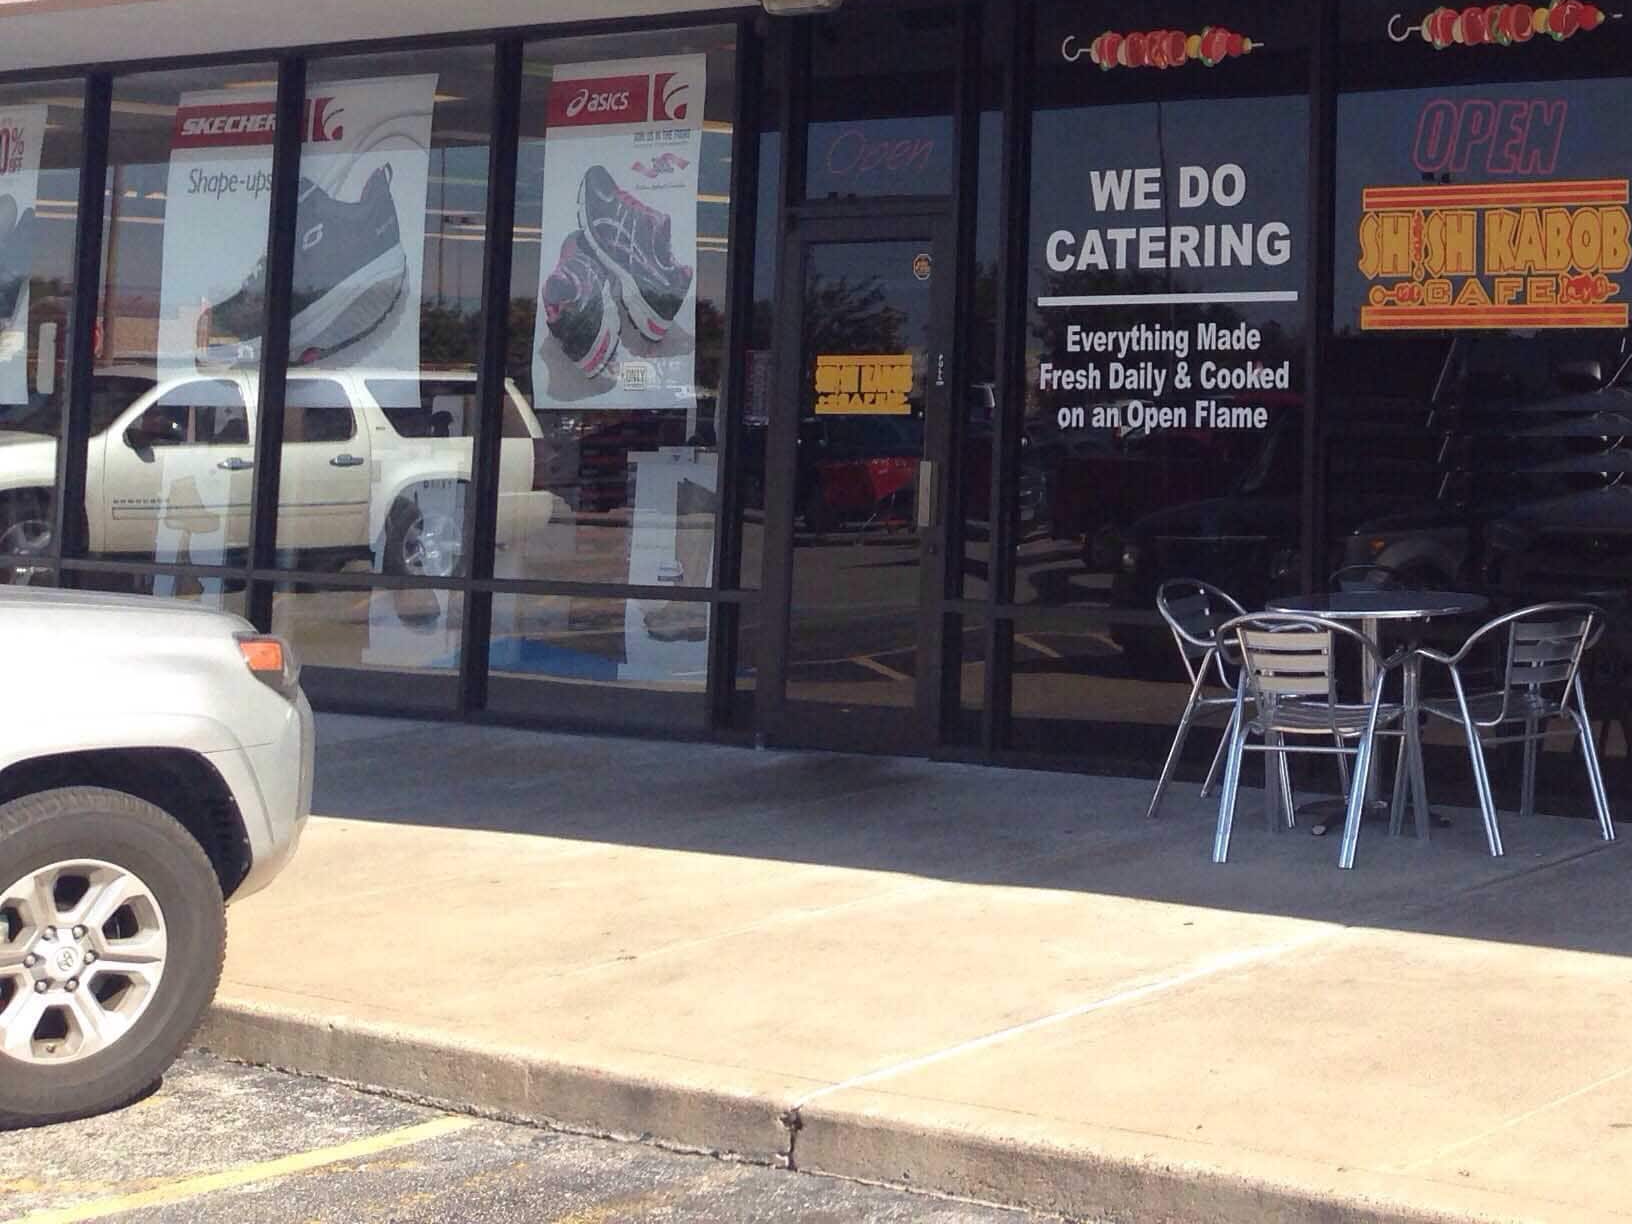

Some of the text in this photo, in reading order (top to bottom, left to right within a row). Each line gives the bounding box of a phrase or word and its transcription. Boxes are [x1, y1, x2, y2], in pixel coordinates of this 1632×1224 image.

[178, 113, 276, 136] SKECHER
[1412, 97, 1568, 174] OPEN
[826, 127, 935, 173] Open
[1090, 163, 1246, 212] WE DO
[1046, 222, 1291, 272] CATERING
[1359, 206, 1632, 280] SHISH KABOB
[1423, 277, 1556, 305] CAFE
[1067, 322, 1261, 359] Everything Made
[1040, 361, 1291, 397] Fresh Daily & Cooked
[1057, 400, 1268, 435] on an Open Flame
